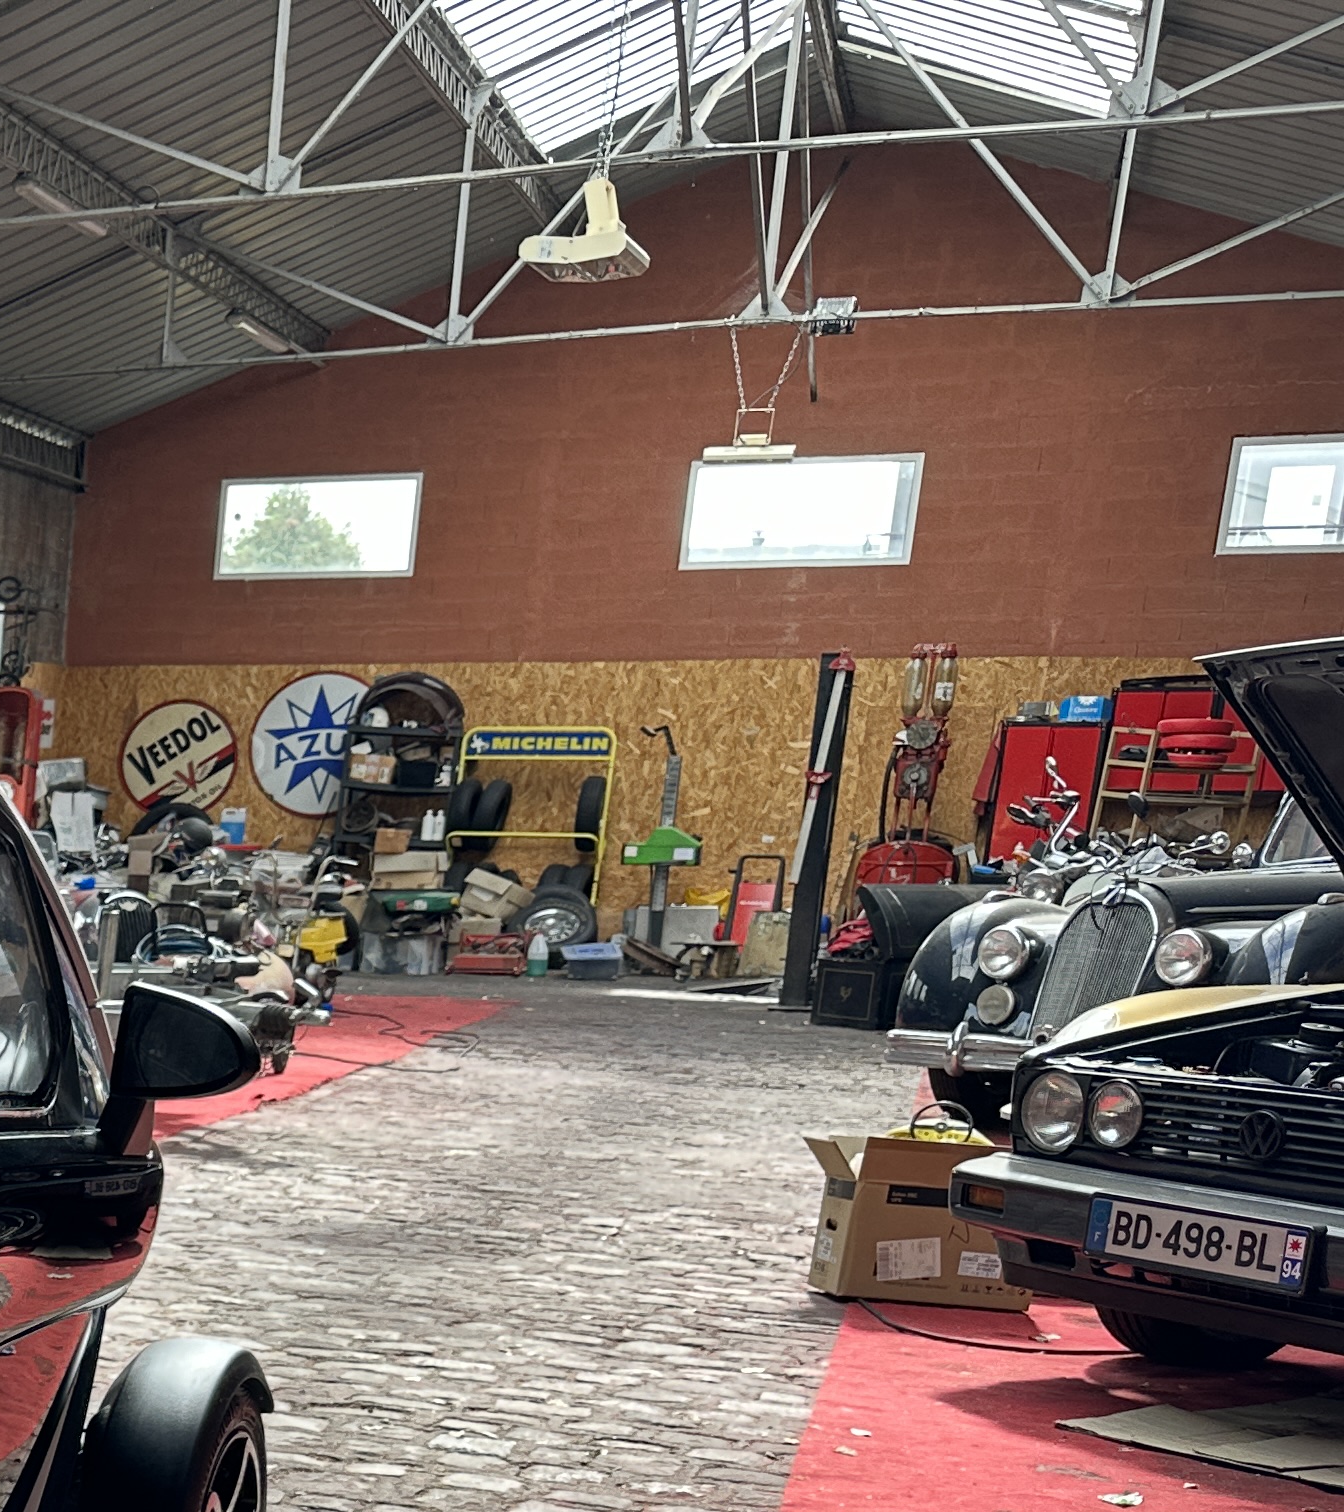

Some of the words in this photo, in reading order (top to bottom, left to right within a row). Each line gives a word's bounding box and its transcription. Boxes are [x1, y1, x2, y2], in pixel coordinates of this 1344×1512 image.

[126, 710, 221, 786] VEEDOL
[274, 732, 347, 769] AZU
[491, 736, 610, 751] MICHELIN
[1094, 1231, 1102, 1243] F
[1111, 1210, 1276, 1272] BD-498-BL
[1281, 1259, 1302, 1280] 94
